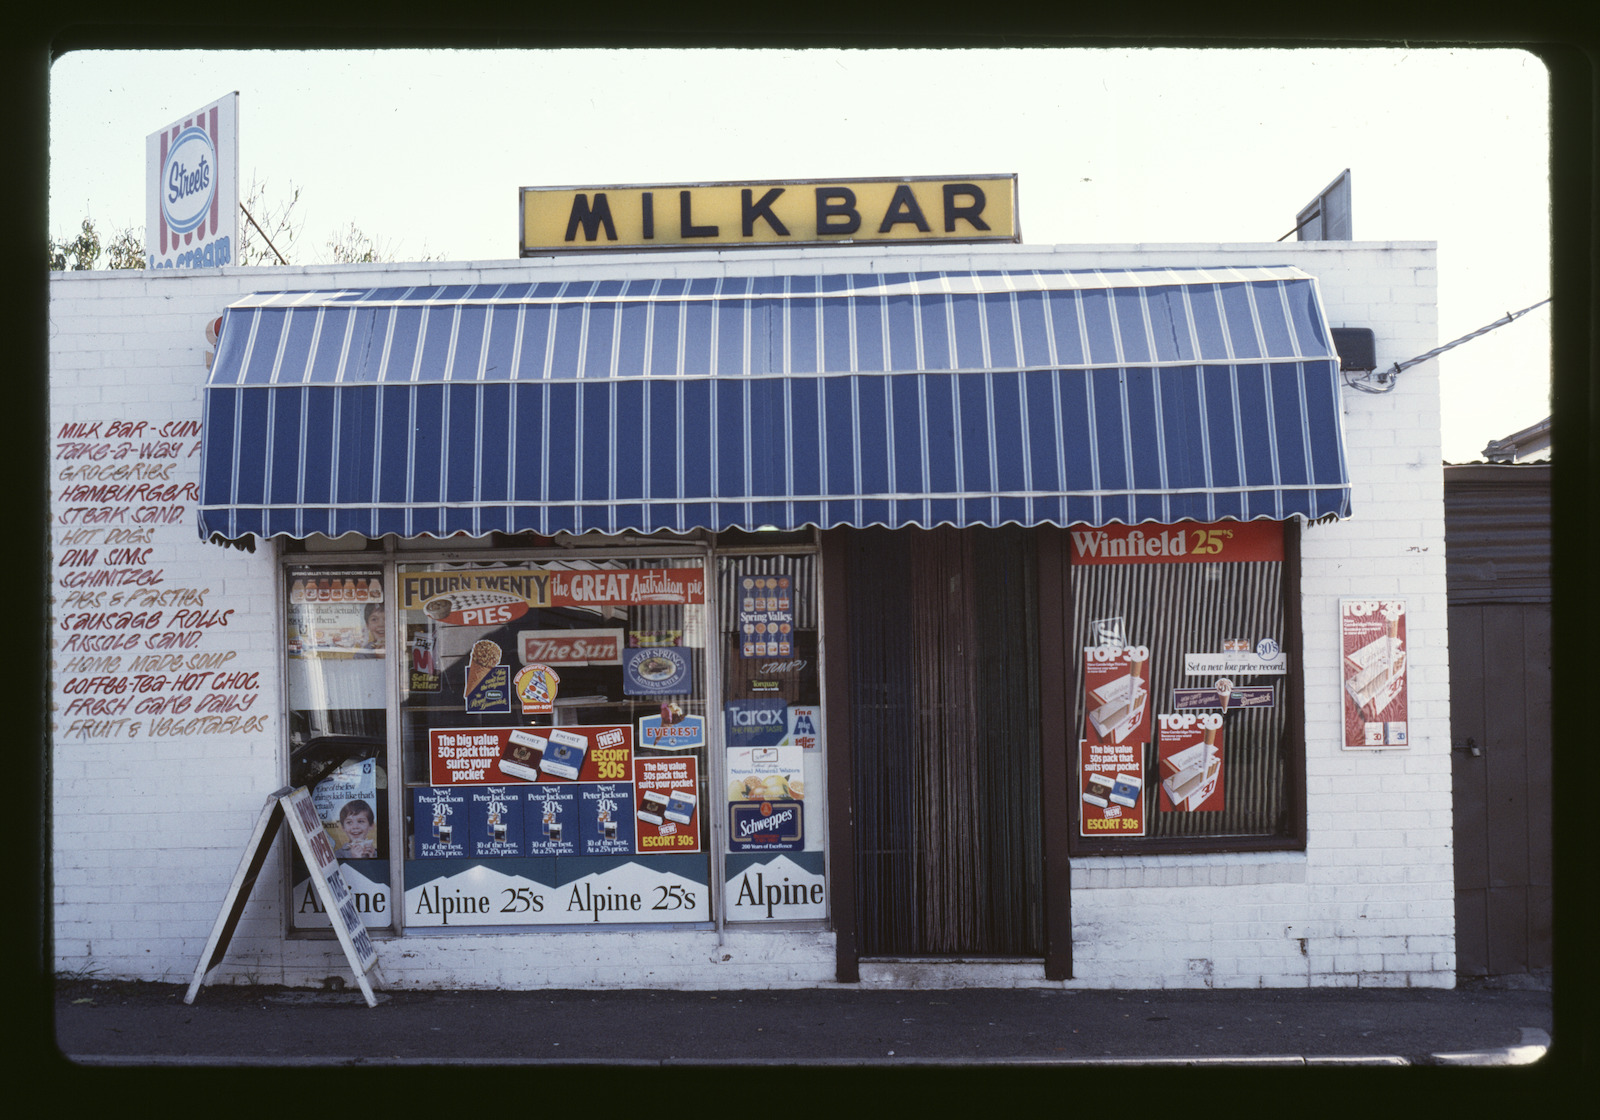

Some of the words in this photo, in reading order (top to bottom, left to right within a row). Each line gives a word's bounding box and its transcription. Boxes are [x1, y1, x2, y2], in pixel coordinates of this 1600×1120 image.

[168, 154, 210, 204] Streets
[564, 188, 791, 242] MILK
[815, 183, 992, 236] BAR
[57, 422, 103, 439] MILK
[59, 462, 177, 481] GROCERIES
[58, 505, 130, 525] STEAK
[59, 527, 104, 546] HOT
[104, 528, 155, 545] DOGS
[1071, 530, 1187, 558] Winfield
[1191, 529, 1234, 555] 25's
[58, 548, 99, 567] DIM
[104, 547, 154, 566] SIMS
[475, 574, 550, 604] TWENTY
[551, 574, 569, 597] the
[571, 573, 629, 602] GREAT
[630, 570, 685, 603] Australian
[688, 575, 704, 603] pie
[124, 588, 210, 607] PASTIES
[463, 605, 513, 625] PIES
[1343, 601, 1379, 617] TOP
[60, 611, 163, 631] SAUSAGE
[167, 609, 235, 629] ROLLS
[740, 611, 767, 624] Spring
[767, 611, 793, 623] Valley.
[61, 633, 141, 653] RISSOLE
[527, 640, 569, 661] The
[570, 638, 616, 660] Sun
[1258, 641, 1279, 656] 30's
[632, 650, 651, 668] DEEP
[652, 649, 683, 667] SPRING
[1084, 646, 1122, 662] TOP
[1123, 645, 1149, 662] 30
[63, 655, 122, 673] HOME
[127, 654, 184, 672] MADE
[185, 651, 237, 670] SOUP
[1187, 662, 1200, 671] Set
[1225, 662, 1238, 671] low
[1239, 662, 1258, 673] price
[1259, 662, 1286, 671] record.
[212, 671, 260, 691] CHOC.
[411, 673, 439, 682] Seller
[412, 682, 438, 690] Feller
[752, 680, 779, 689] Torquay
[63, 695, 135, 716] FRESH
[134, 694, 192, 715] CAKE
[194, 693, 259, 714] DAILY
[729, 707, 784, 727] Tarax
[1158, 713, 1196, 730] TOP
[1197, 712, 1224, 730] 30
[63, 718, 132, 739] FRUIT
[148, 715, 269, 738] VEGETABLES
[647, 727, 699, 738] EVEREST
[438, 735, 455, 747] The
[457, 734, 471, 748] big
[472, 734, 499, 746] value
[598, 731, 622, 747] NEW
[795, 736, 815, 744] seller
[438, 747, 454, 758] 30s
[456, 746, 478, 759] pack
[479, 746, 500, 757] that
[591, 749, 630, 762] ESCORT
[1091, 746, 1103, 754] The
[446, 758, 469, 770] suits
[470, 759, 492, 770] your
[1090, 754, 1102, 762] 30s
[1103, 753, 1118, 764] pack
[1118, 753, 1134, 762] that
[598, 761, 625, 779] 30s
[644, 763, 656, 771] The
[657, 763, 668, 773] big
[668, 762, 687, 771] value
[1085, 763, 1101, 771] suits
[1101, 763, 1116, 772] your
[1116, 762, 1139, 771] pocket
[452, 769, 485, 782] pocket
[656, 771, 672, 781] pack
[673, 770, 688, 779] that
[542, 786, 561, 794] New!
[597, 784, 616, 792] New!
[639, 780, 655, 789] suits
[656, 780, 670, 790] your
[671, 779, 694, 789] pocket
[433, 788, 451, 796] New!
[473, 794, 491, 802] Peter
[491, 794, 519, 802] Jackson
[528, 793, 546, 801] Peter
[546, 793, 574, 802] Jackson
[583, 792, 601, 800] Peter
[601, 791, 629, 800] Jackson
[437, 796, 464, 804] Jackson
[541, 800, 562, 813] 30's
[596, 799, 618, 812] 30's
[432, 803, 453, 816] 30's
[486, 801, 508, 814] 30's
[1104, 808, 1120, 817] NEW
[740, 809, 793, 837] Schweppes
[1087, 819, 1120, 830] ESCORT
[1122, 818, 1139, 830] 30s
[660, 825, 677, 835] NEW
[642, 836, 676, 847] ESCORT
[678, 835, 694, 846] 30s
[566, 882, 642, 922] Alpine
[652, 885, 696, 911] 25's
[735, 872, 824, 919] Alpine
[414, 883, 490, 924] Alpine
[500, 887, 544, 914] 25's
